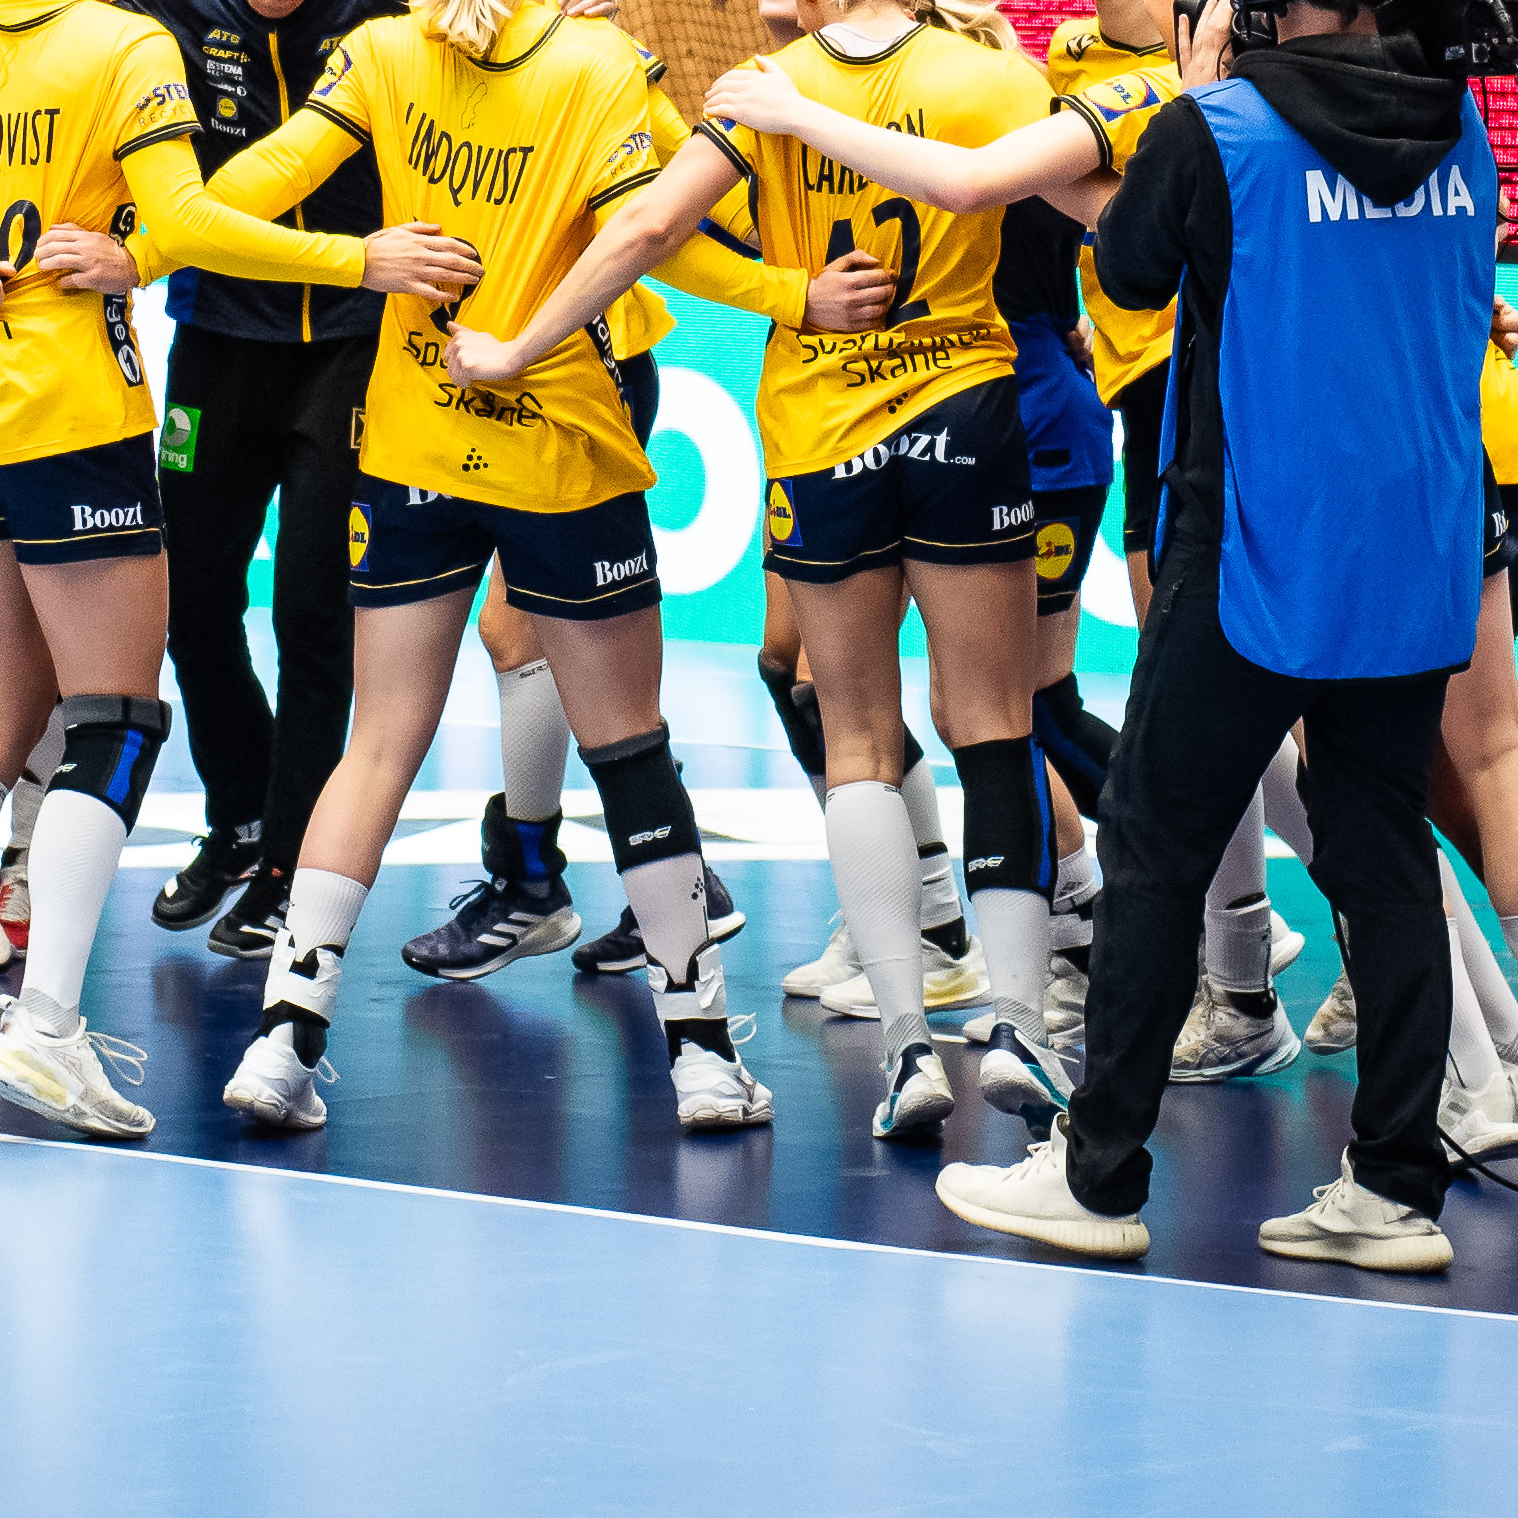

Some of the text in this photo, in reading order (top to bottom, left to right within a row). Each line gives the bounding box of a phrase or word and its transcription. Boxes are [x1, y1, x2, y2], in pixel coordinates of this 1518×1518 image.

[318, 36, 344, 51] AT
[70, 501, 144, 531] Boozt
[991, 500, 1034, 531] Boo
